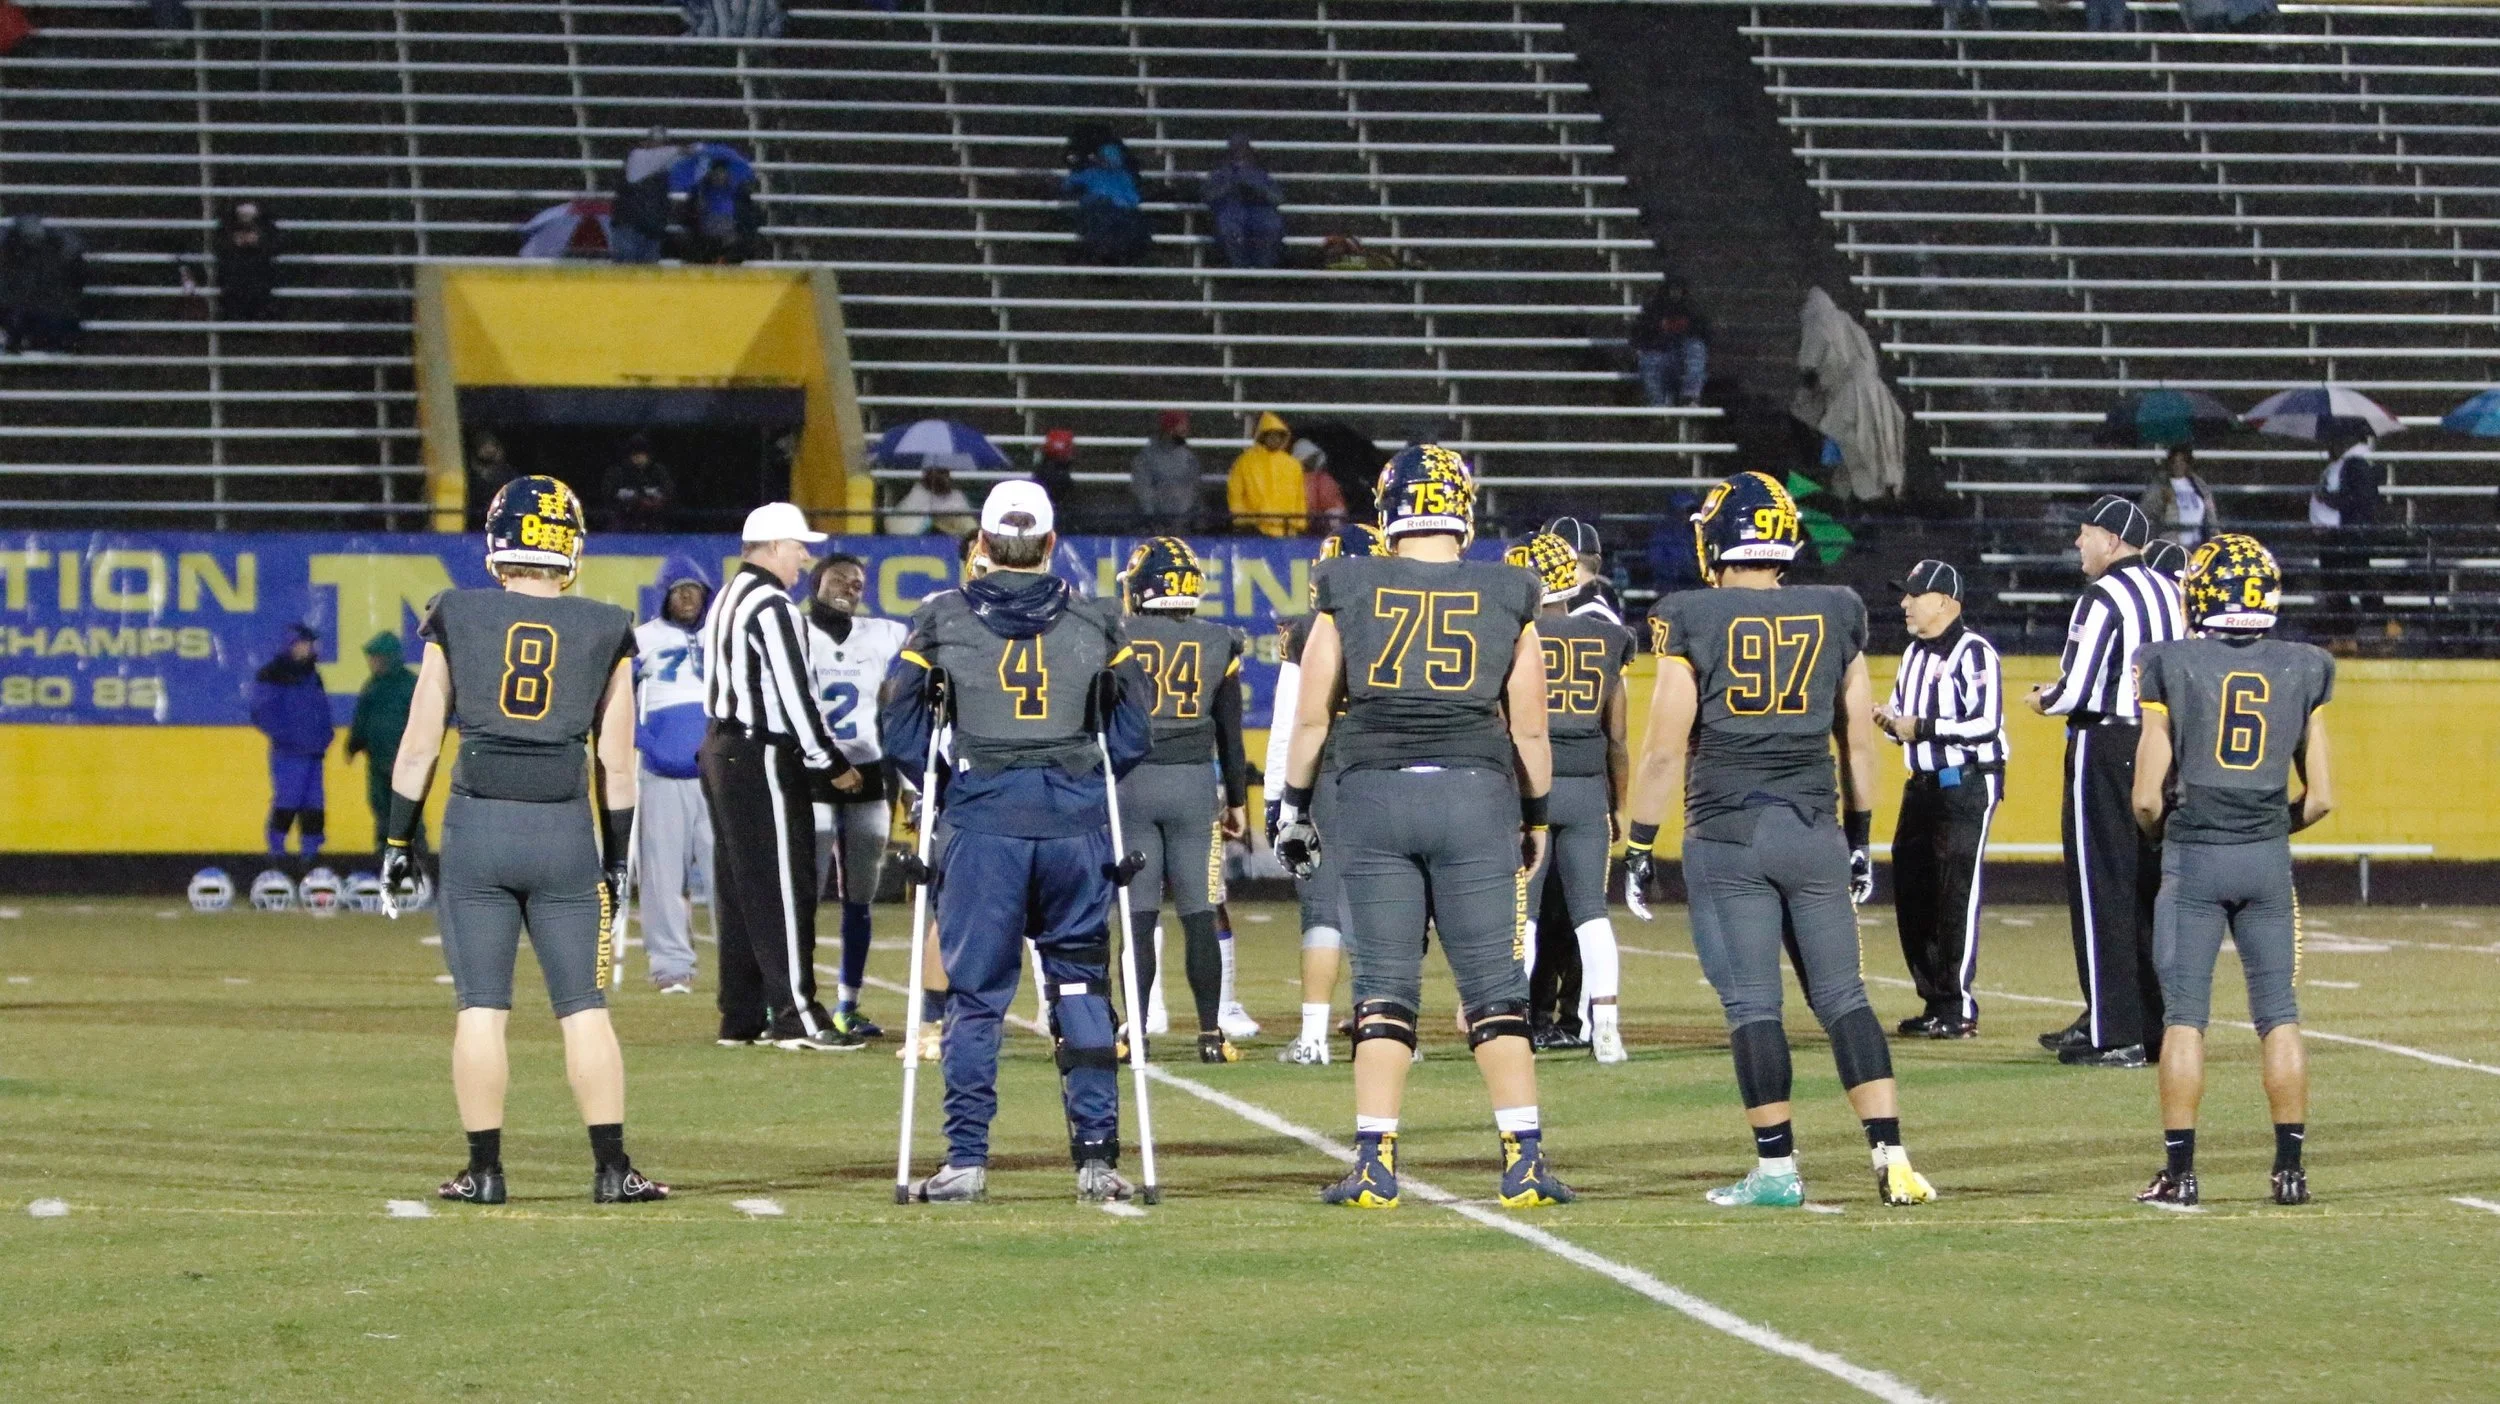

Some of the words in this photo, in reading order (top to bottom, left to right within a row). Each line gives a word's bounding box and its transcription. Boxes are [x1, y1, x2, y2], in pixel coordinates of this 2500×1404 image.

[1408, 482, 1445, 514] 75
[521, 514, 541, 546] 8
[1407, 520, 1447, 529] Riddell
[1754, 509, 1786, 540] 97
[1744, 548, 1788, 558] Riddell
[0, 551, 257, 613] TION
[1164, 572, 1193, 596] 34
[1555, 560, 1579, 589] 25
[2243, 577, 2263, 607] 6
[2225, 617, 2269, 627] Riddell
[0, 627, 211, 659] HAMPS
[1368, 588, 1478, 691] 75
[499, 622, 558, 721] 8
[998, 634, 1048, 719] 4
[1132, 640, 1202, 718] 34
[1538, 636, 1606, 714] 25
[1726, 614, 1824, 715] 97
[2, 676, 72, 708] 80
[821, 681, 860, 740] 2
[2215, 671, 2270, 770] 6
